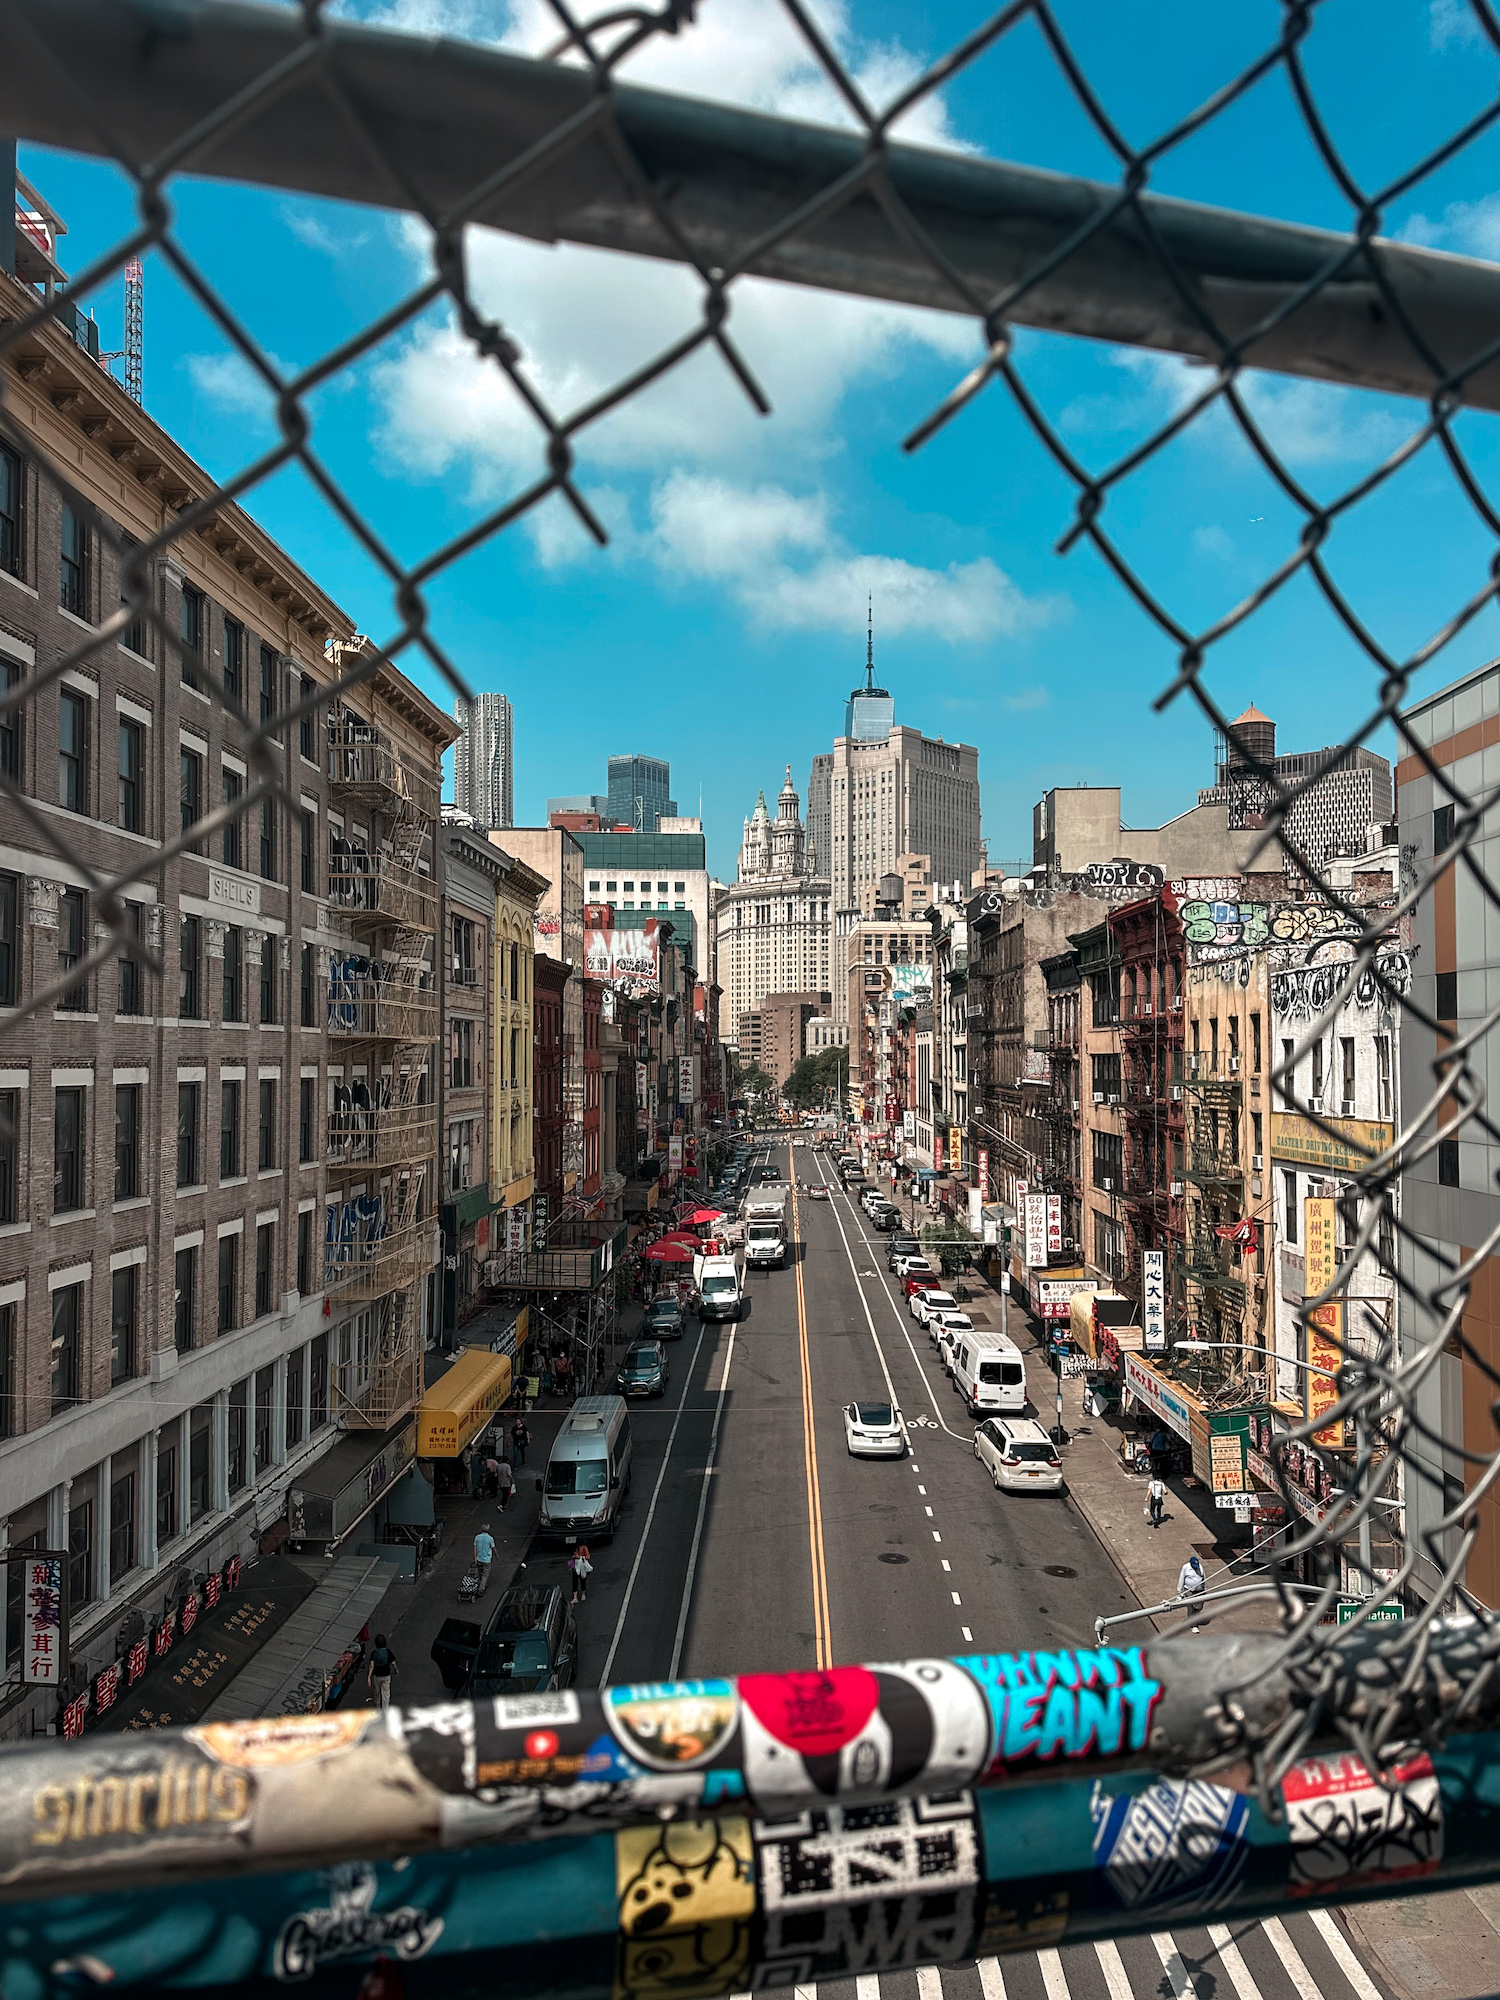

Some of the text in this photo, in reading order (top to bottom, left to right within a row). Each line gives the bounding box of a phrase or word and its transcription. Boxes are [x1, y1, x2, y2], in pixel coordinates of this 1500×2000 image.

[215, 878, 253, 905] SHEILS
[1280, 1116, 1355, 1142] 廣州駕校
[1276, 1136, 1303, 1149] EASTERN
[1305, 1139, 1333, 1153] DRIVING
[1335, 1144, 1364, 1158] SCHOOL
[1028, 1196, 1043, 1265] 60號怡豐商場
[1145, 1253, 1162, 1338] 開心大藥房
[1343, 1610, 1398, 1620] Maattan
